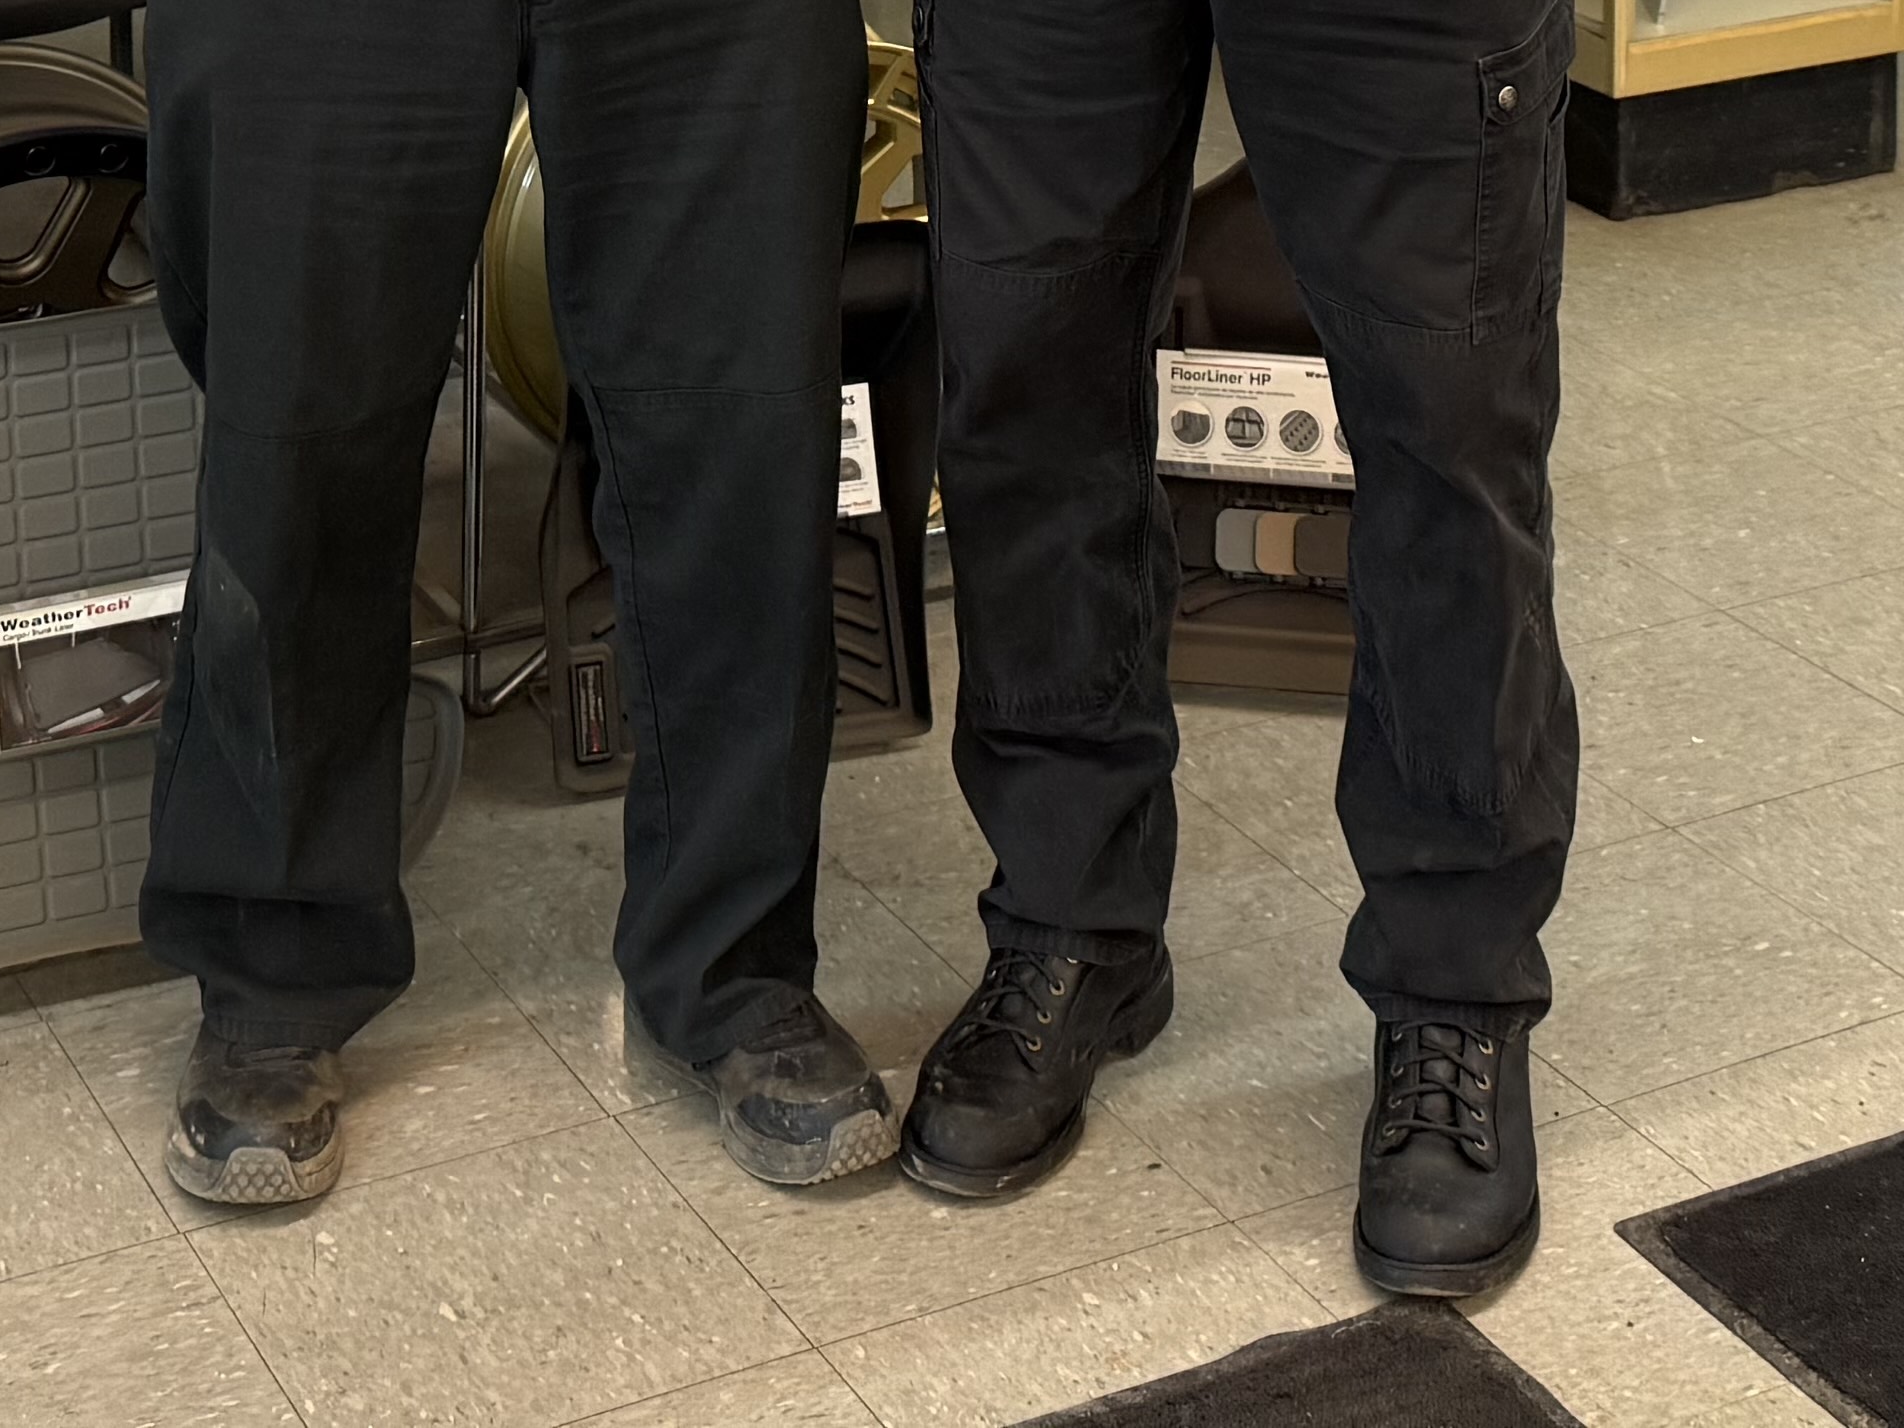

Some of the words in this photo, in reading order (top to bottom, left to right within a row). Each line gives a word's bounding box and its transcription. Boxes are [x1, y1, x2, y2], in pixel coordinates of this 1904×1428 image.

[1171, 367, 1242, 385] FloorLiner
[1250, 372, 1271, 386] HP
[0, 597, 131, 632] WeatherTech
